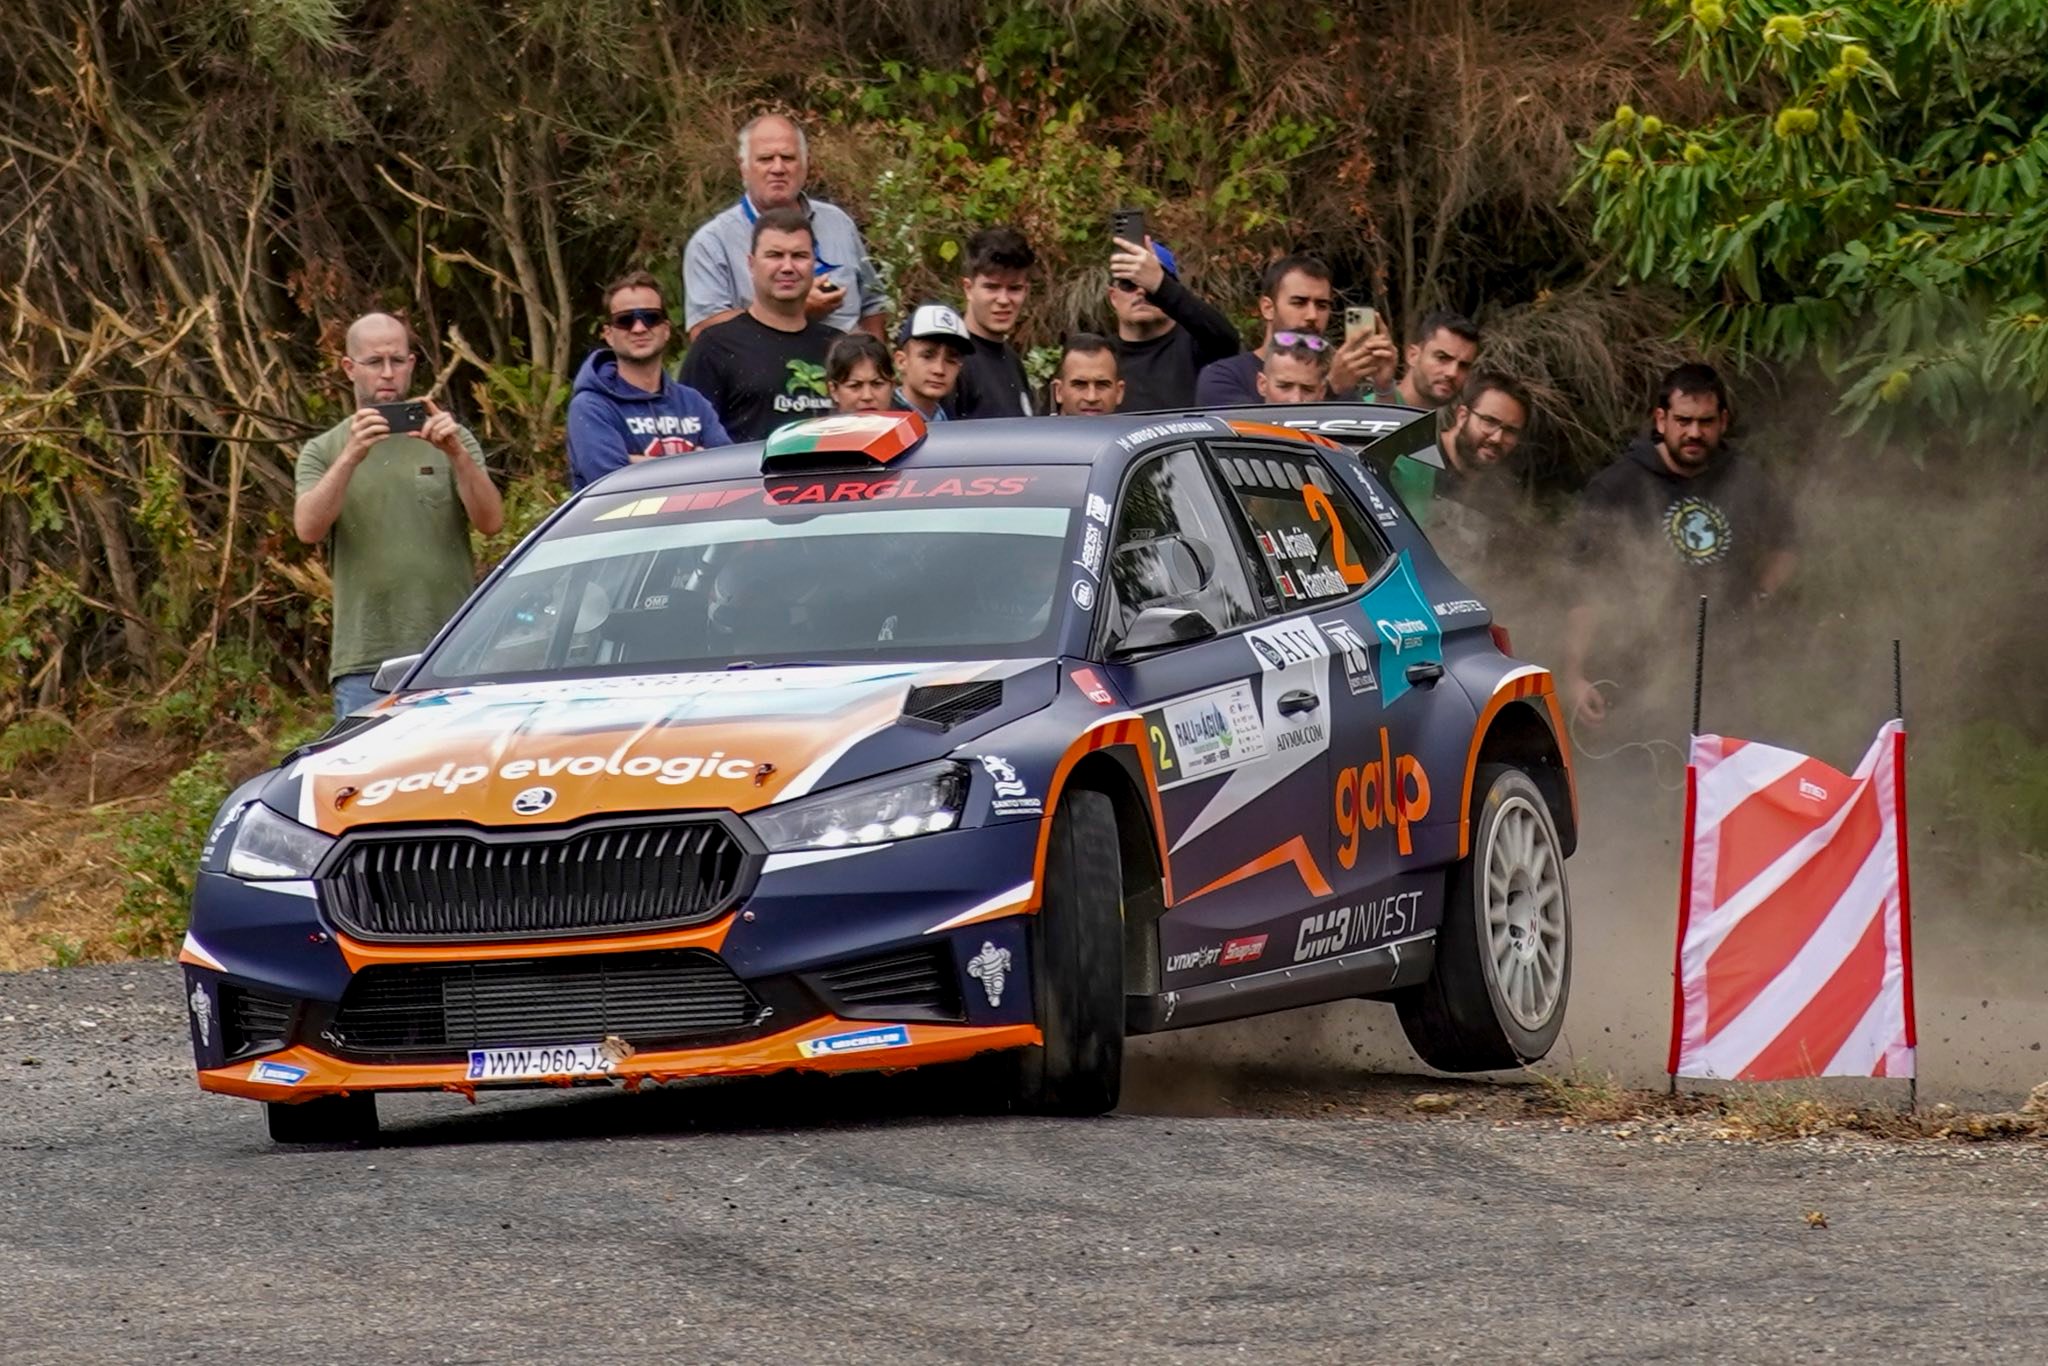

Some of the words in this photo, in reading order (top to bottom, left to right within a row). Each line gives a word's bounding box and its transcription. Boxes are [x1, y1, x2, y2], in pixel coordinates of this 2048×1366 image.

[763, 477, 1032, 506] CARGLASS
[1302, 483, 1369, 585] 2
[644, 595, 669, 610] OMP
[1284, 570, 1306, 600] L.
[1296, 565, 1349, 598] Ramalho
[1271, 629, 1322, 663] AIV
[1150, 725, 1173, 770] 2
[1174, 719, 1198, 747] RALI
[1200, 711, 1227, 740] ÁGUA
[356, 763, 489, 806] galp
[500, 748, 756, 785] evologic
[1335, 726, 1431, 870] galp
[1349, 891, 1423, 945] INVEST
